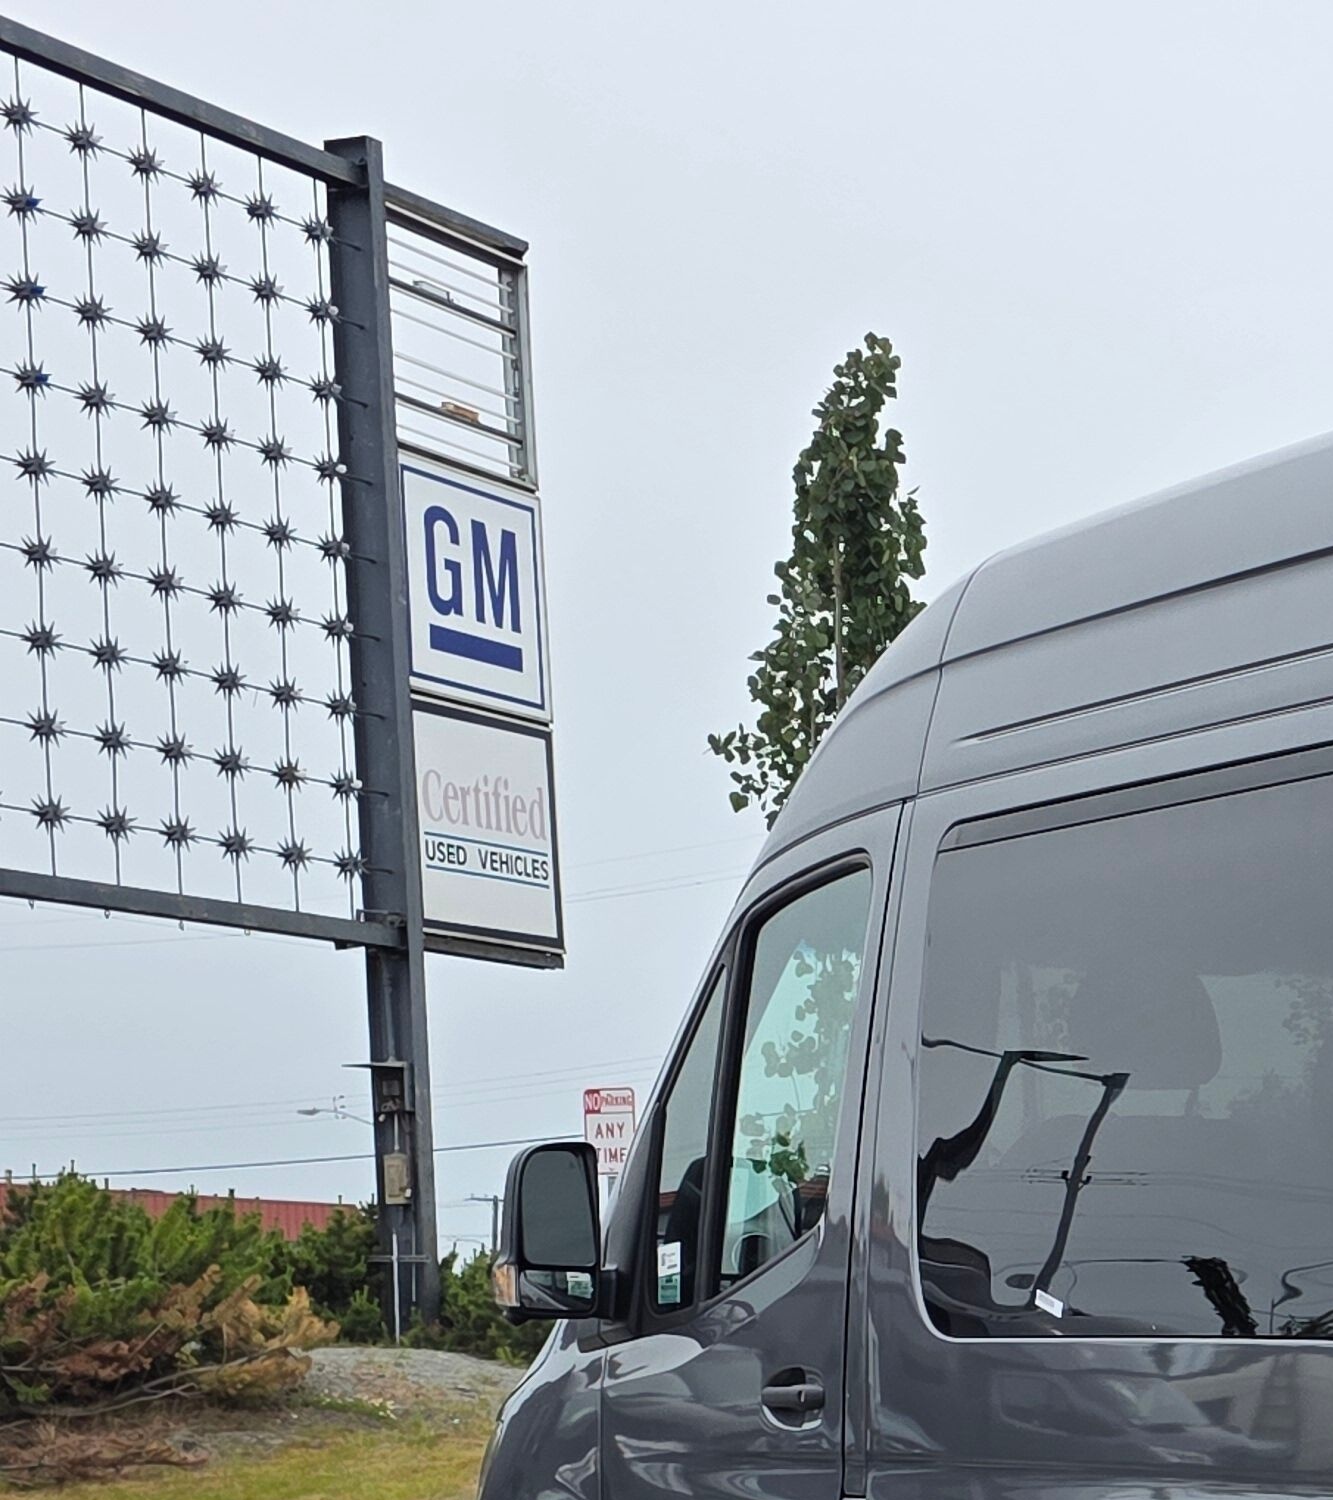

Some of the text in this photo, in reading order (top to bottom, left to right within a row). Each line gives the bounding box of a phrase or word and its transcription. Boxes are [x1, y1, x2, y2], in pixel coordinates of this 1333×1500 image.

[424, 505, 522, 634] GM
[422, 769, 547, 841] Certified
[425, 839, 550, 880] USED VEHICLES
[585, 1092, 601, 1111] NO
[595, 1122, 625, 1139] ANY
